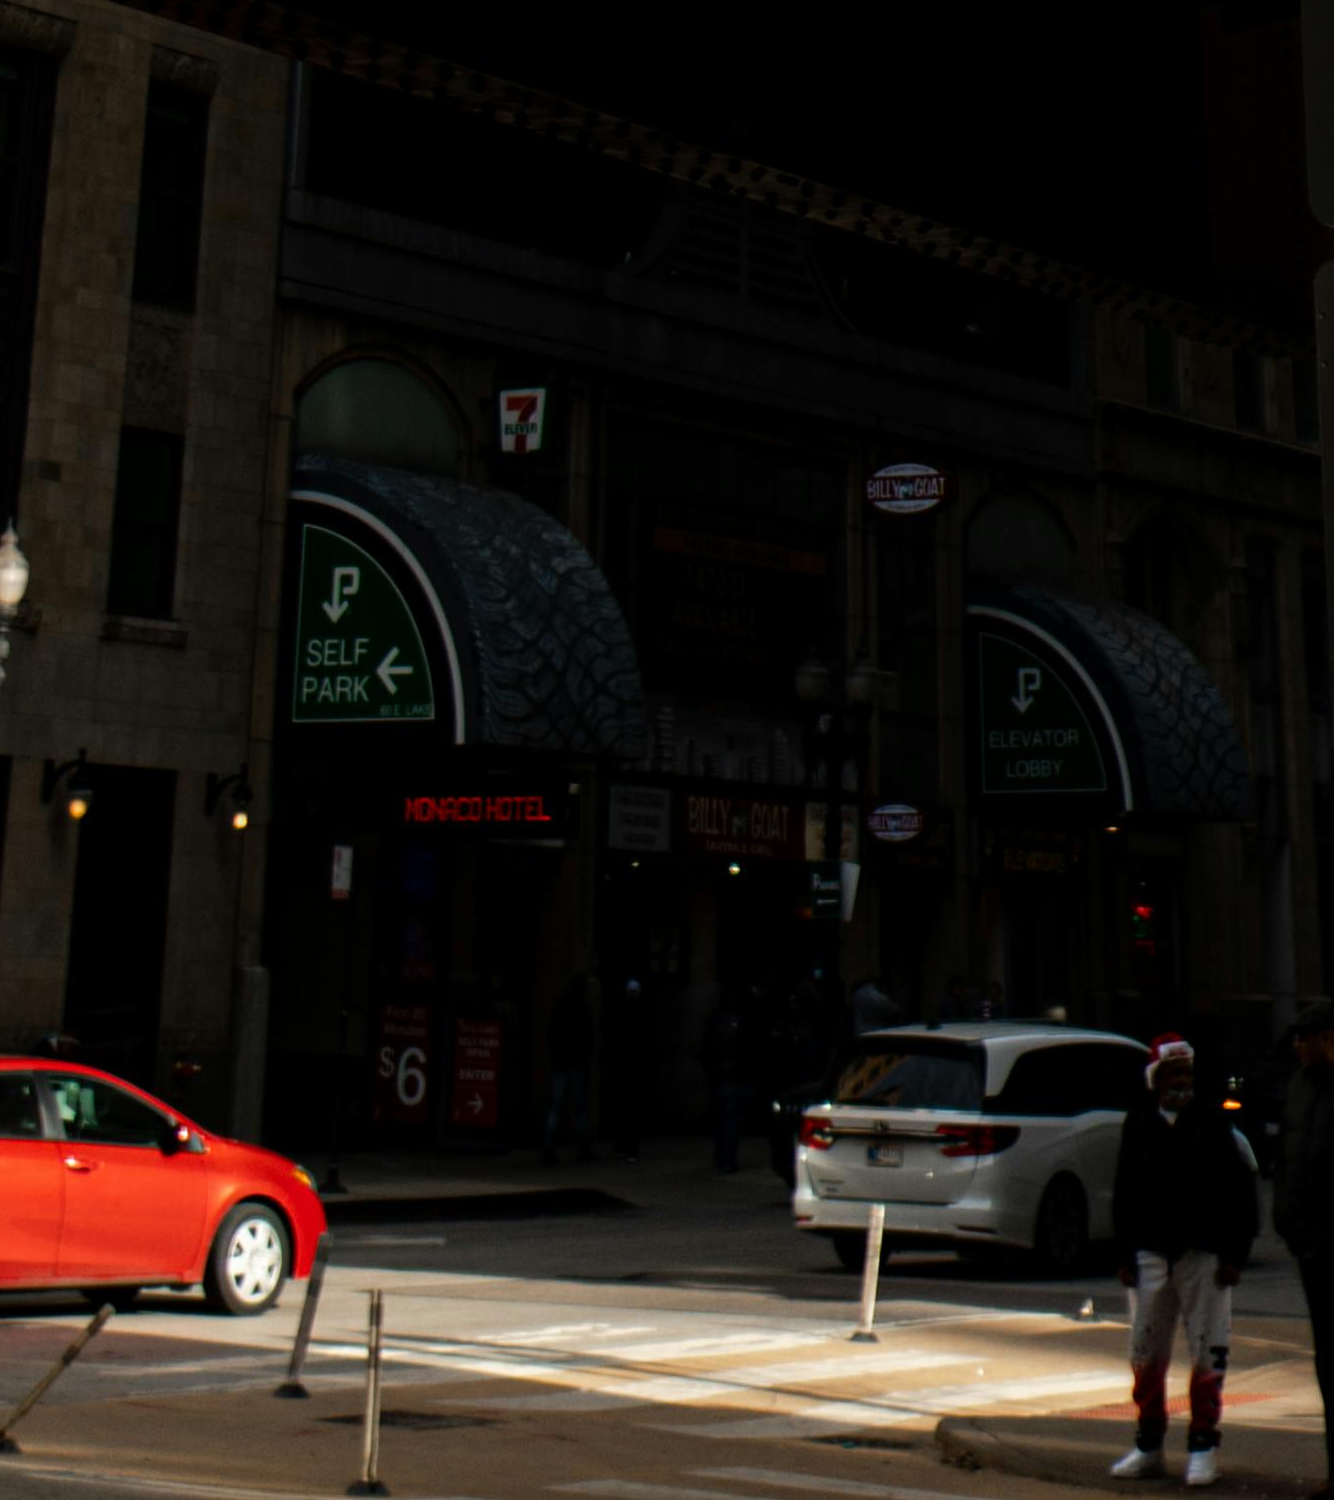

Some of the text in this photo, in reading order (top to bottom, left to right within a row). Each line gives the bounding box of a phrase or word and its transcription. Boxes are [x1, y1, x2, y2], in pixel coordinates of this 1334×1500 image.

[507, 395, 538, 454] 7
[867, 477, 946, 500] BILLY GOAT
[306, 637, 370, 668] SELF
[301, 675, 370, 704] PARK
[988, 728, 1080, 749] ELEVATOR
[1005, 758, 1063, 779] LOBBY
[404, 797, 553, 822] MONACO HOTEL
[687, 795, 731, 836] BILLY
[750, 802, 790, 841] GOAT
[379, 1045, 427, 1106] $6
[458, 1067, 495, 1081] ENTER
